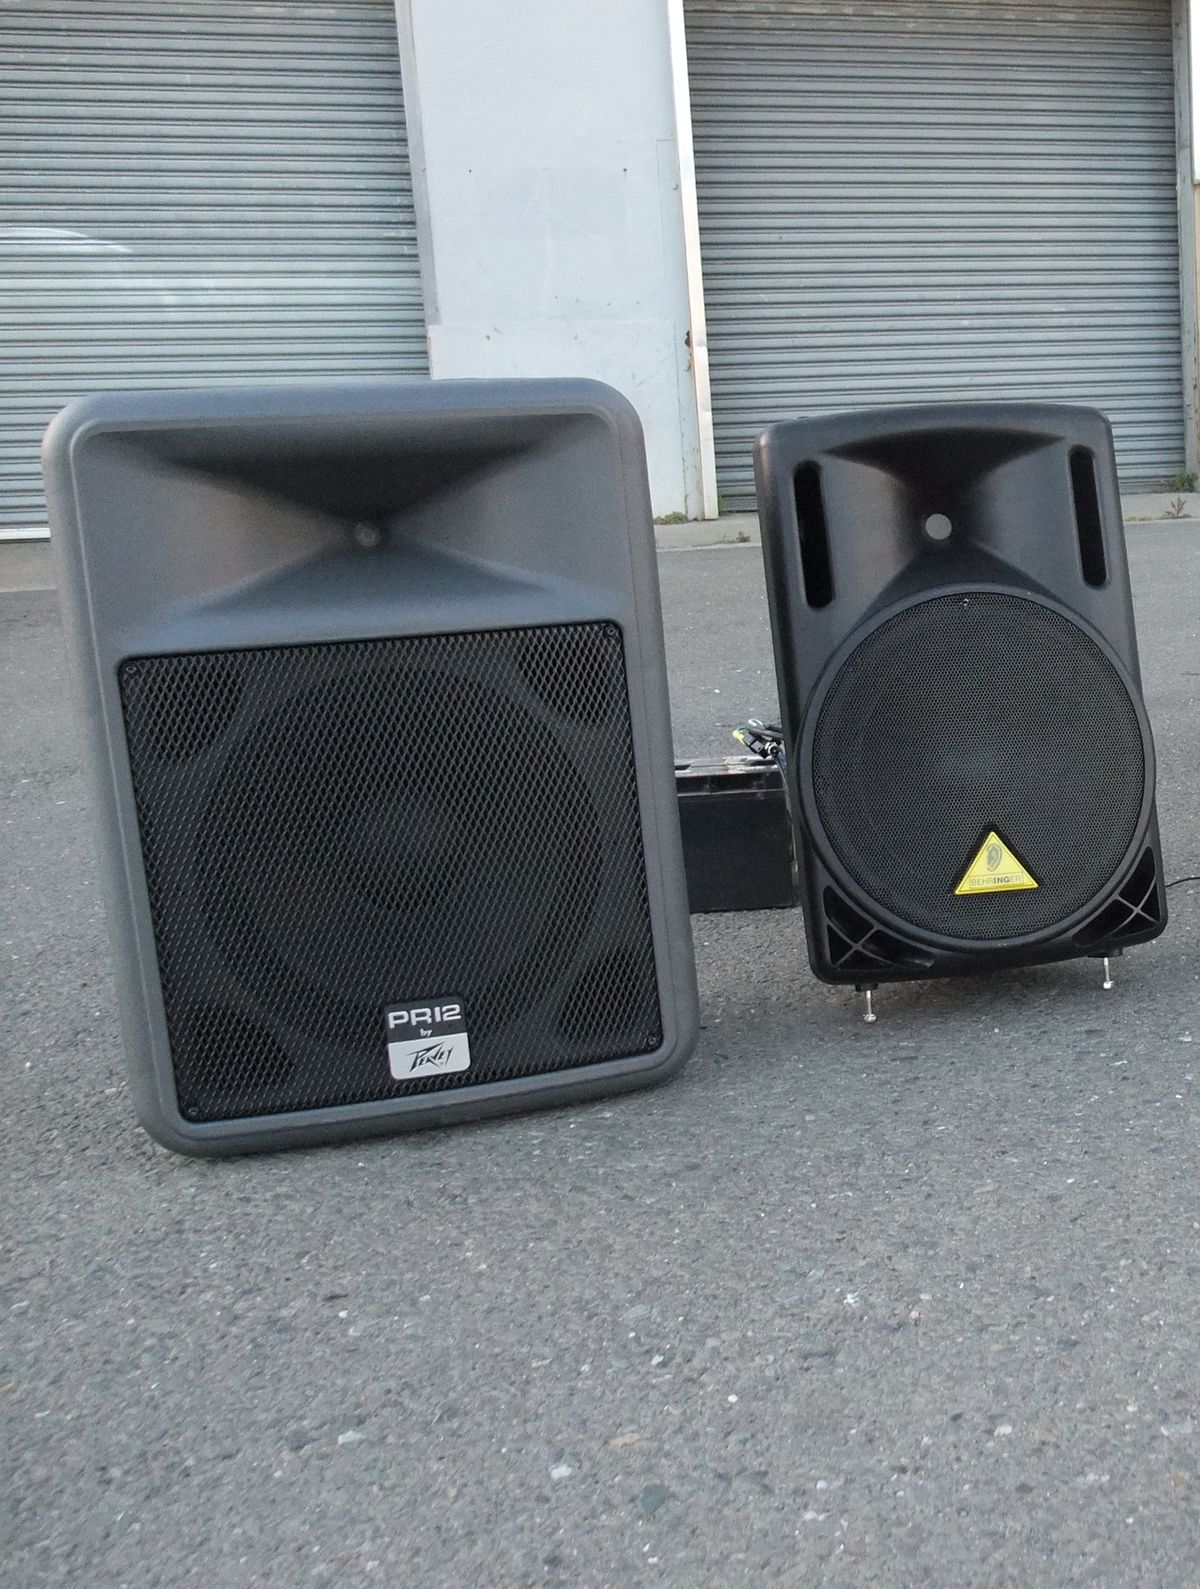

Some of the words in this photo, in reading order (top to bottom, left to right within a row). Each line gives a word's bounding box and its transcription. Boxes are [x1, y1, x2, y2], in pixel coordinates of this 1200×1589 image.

[971, 874, 1021, 887] BEHRINGER
[388, 1004, 462, 1029] PR12
[420, 1028, 432, 1037] by
